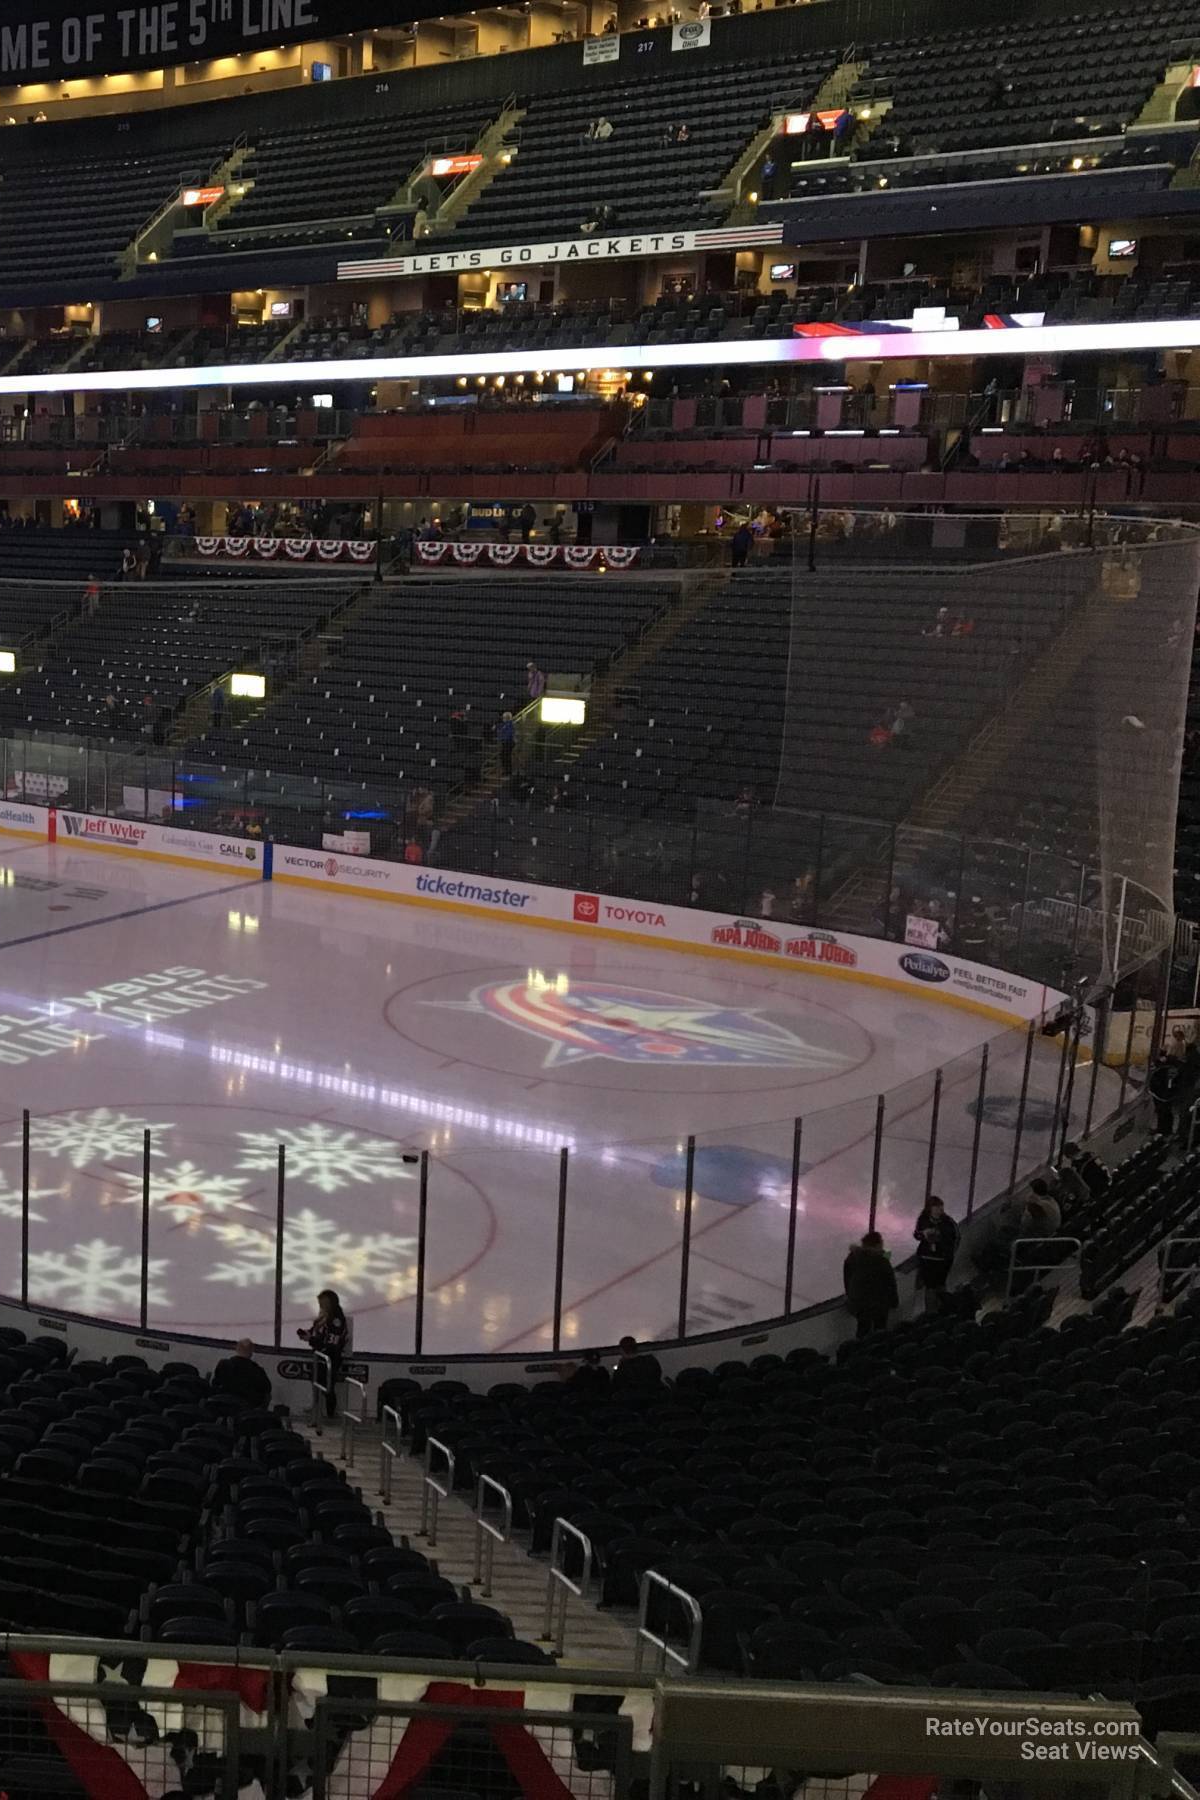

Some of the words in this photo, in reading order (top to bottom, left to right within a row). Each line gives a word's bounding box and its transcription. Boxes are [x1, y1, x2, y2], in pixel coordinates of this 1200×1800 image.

[61, 14, 104, 64] OF
[117, 2, 178, 57] THE
[637, 41, 655, 53] 217
[412, 252, 482, 272] LET'S
[500, 246, 533, 264] GO
[548, 235, 686, 260] JACKETS
[471, 507, 493, 518] BUD
[84, 818, 107, 834] Jeff
[109, 823, 147, 839] Wyler
[220, 844, 244, 856] CALL
[284, 855, 324, 870] VECTOR
[339, 864, 391, 880] SECURITY
[416, 873, 530, 908] ticketmaster
[604, 905, 667, 928] TOYOTA
[713, 927, 742, 946] PAPA
[787, 939, 817, 959] PAPA
[903, 956, 950, 979] Pedialyte
[954, 967, 974, 981] FEEL
[976, 974, 1008, 993] BETTER
[1008, 984, 1029, 999] FAST
[94, 973, 269, 1030] JACKETS
